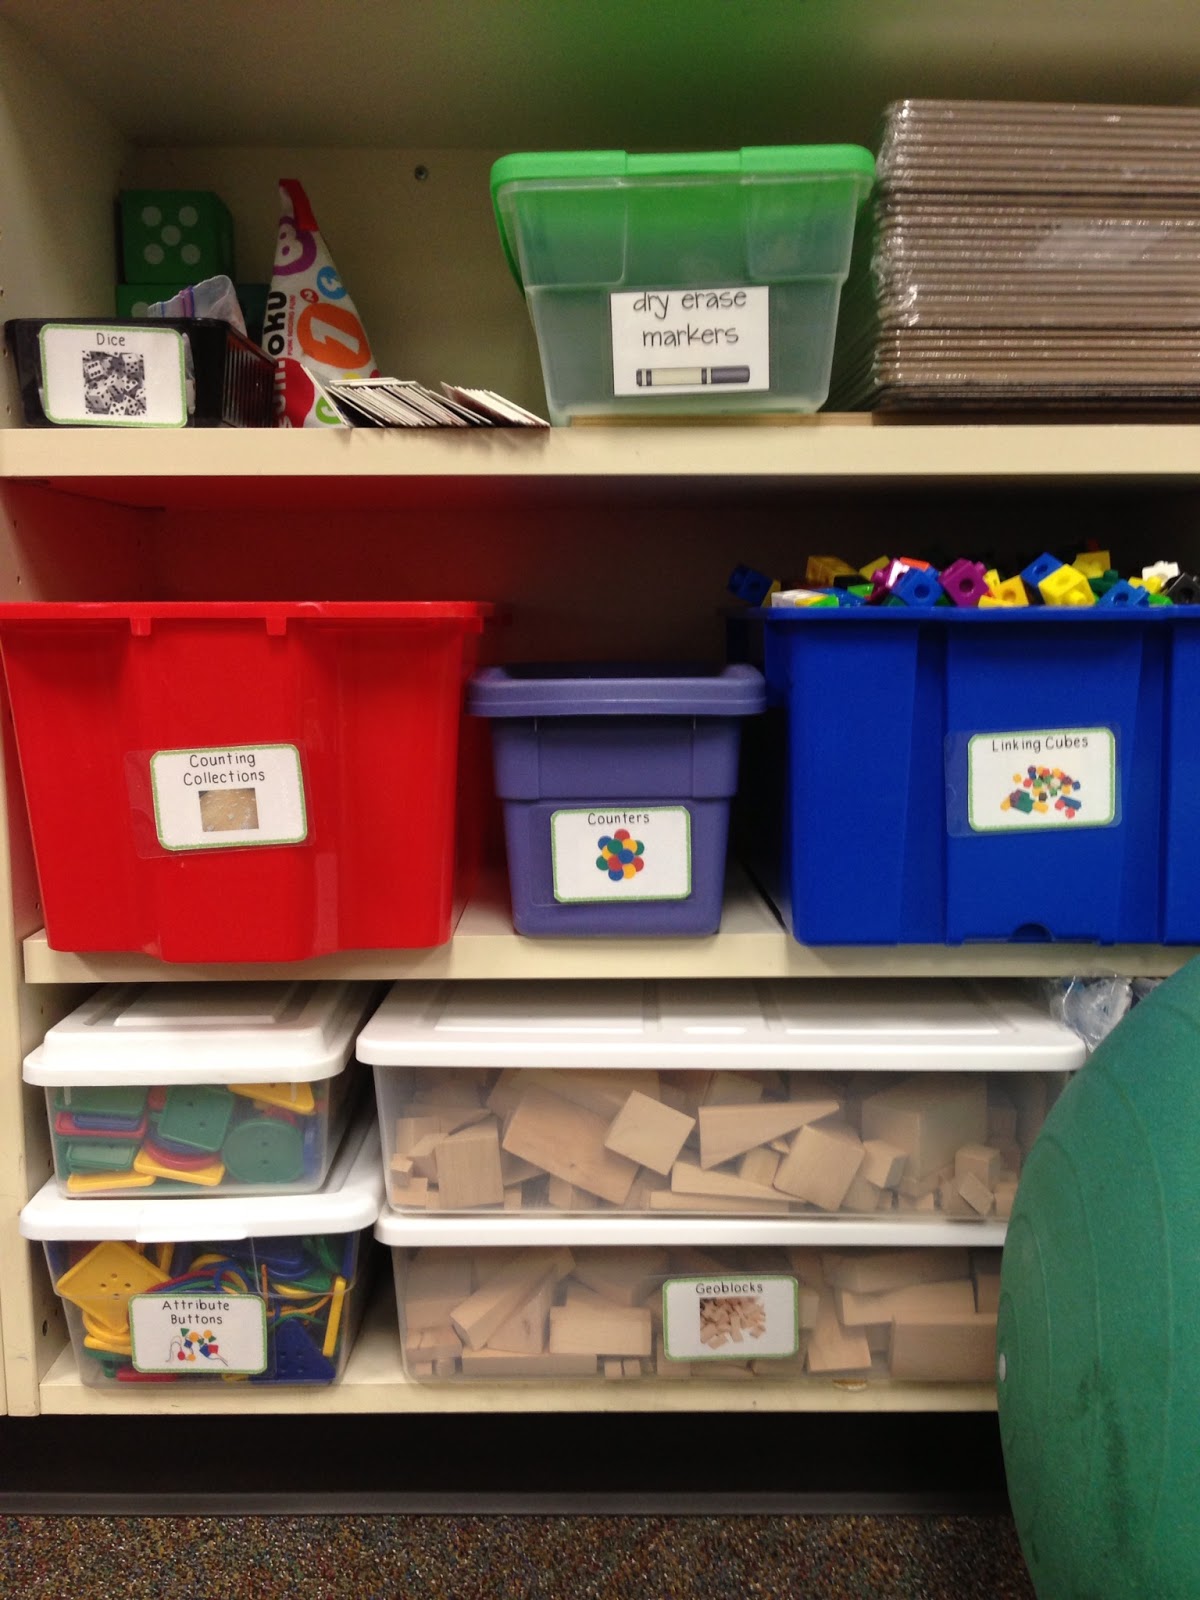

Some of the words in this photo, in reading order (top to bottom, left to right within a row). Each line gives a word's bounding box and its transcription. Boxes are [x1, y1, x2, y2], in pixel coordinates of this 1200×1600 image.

[633, 291, 669, 320] dry
[681, 291, 747, 310] erase
[96, 332, 125, 347] Dice
[309, 316, 360, 355] 1
[642, 323, 739, 347] markers
[992, 738, 1041, 754] Linking
[1045, 734, 1089, 750] Cubes
[189, 752, 256, 768] Counting
[183, 770, 266, 786] Collections
[587, 812, 650, 826] Counters
[695, 1281, 763, 1294] Geoblocks
[162, 1299, 230, 1311] Attribute
[170, 1313, 223, 1325] Buttons
